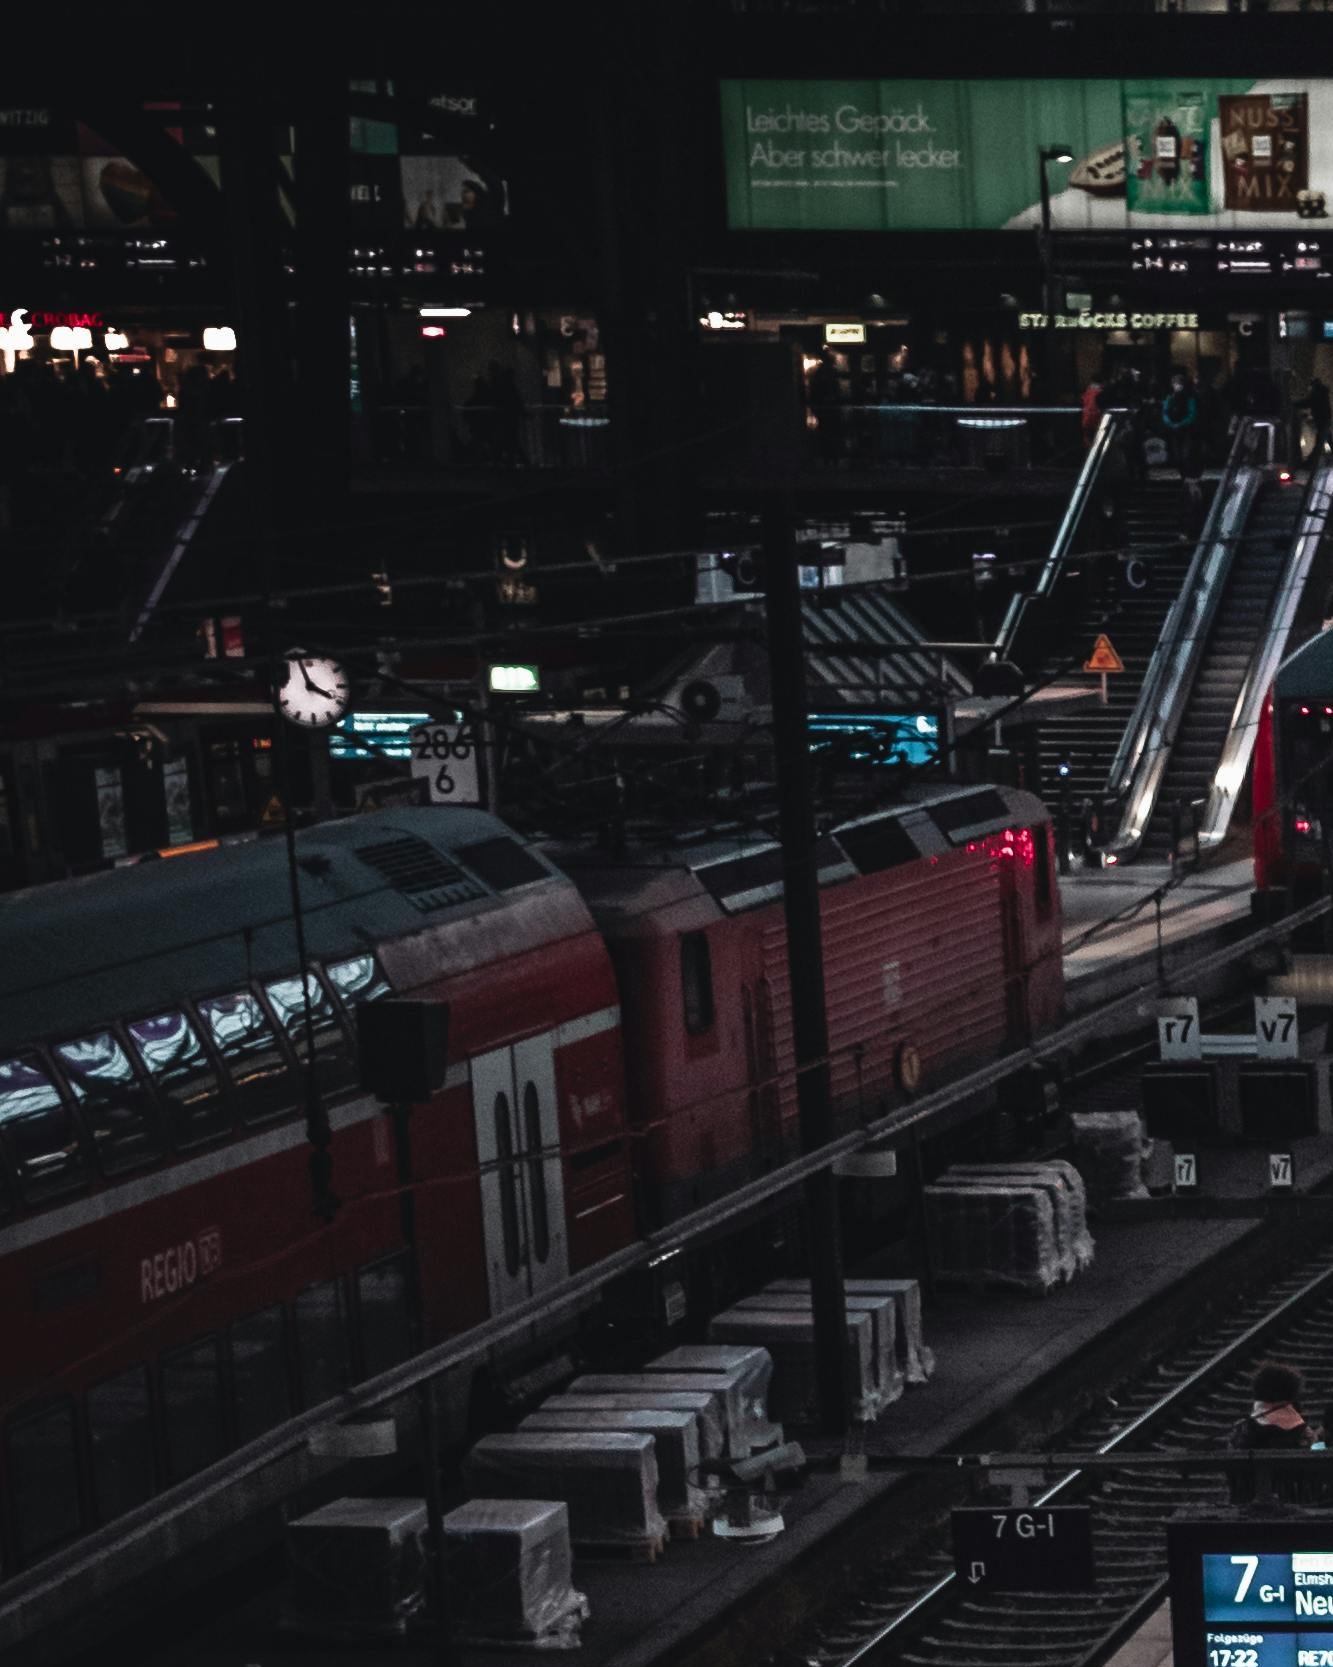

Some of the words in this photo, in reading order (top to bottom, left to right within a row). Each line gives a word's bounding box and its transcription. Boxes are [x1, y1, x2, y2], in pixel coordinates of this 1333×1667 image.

[746, 104, 830, 133] Leichtes
[835, 102, 937, 138] Gepäck.
[1229, 107, 1295, 127] NUSS
[750, 138, 805, 168] Aber
[812, 139, 889, 168] schwer
[1237, 175, 1293, 198] MIX
[1130, 312, 1198, 328] COFFEE
[1126, 560, 1148, 589] C
[413, 727, 476, 760] 286
[435, 764, 455, 794] 6
[1163, 1013, 1194, 1044] r7
[1260, 1013, 1296, 1043] v7
[1178, 1159, 1193, 1182] r7
[1272, 1159, 1290, 1181] v7
[141, 1240, 197, 1304] REGIO
[992, 1514, 1008, 1538] 7
[1015, 1513, 1055, 1538] G-I
[1230, 1556, 1259, 1603] 7
[1259, 1585, 1285, 1602] G-I
[1206, 1633, 1264, 1646] Folgezüge
[1209, 1649, 1258, 1667] 17:22
